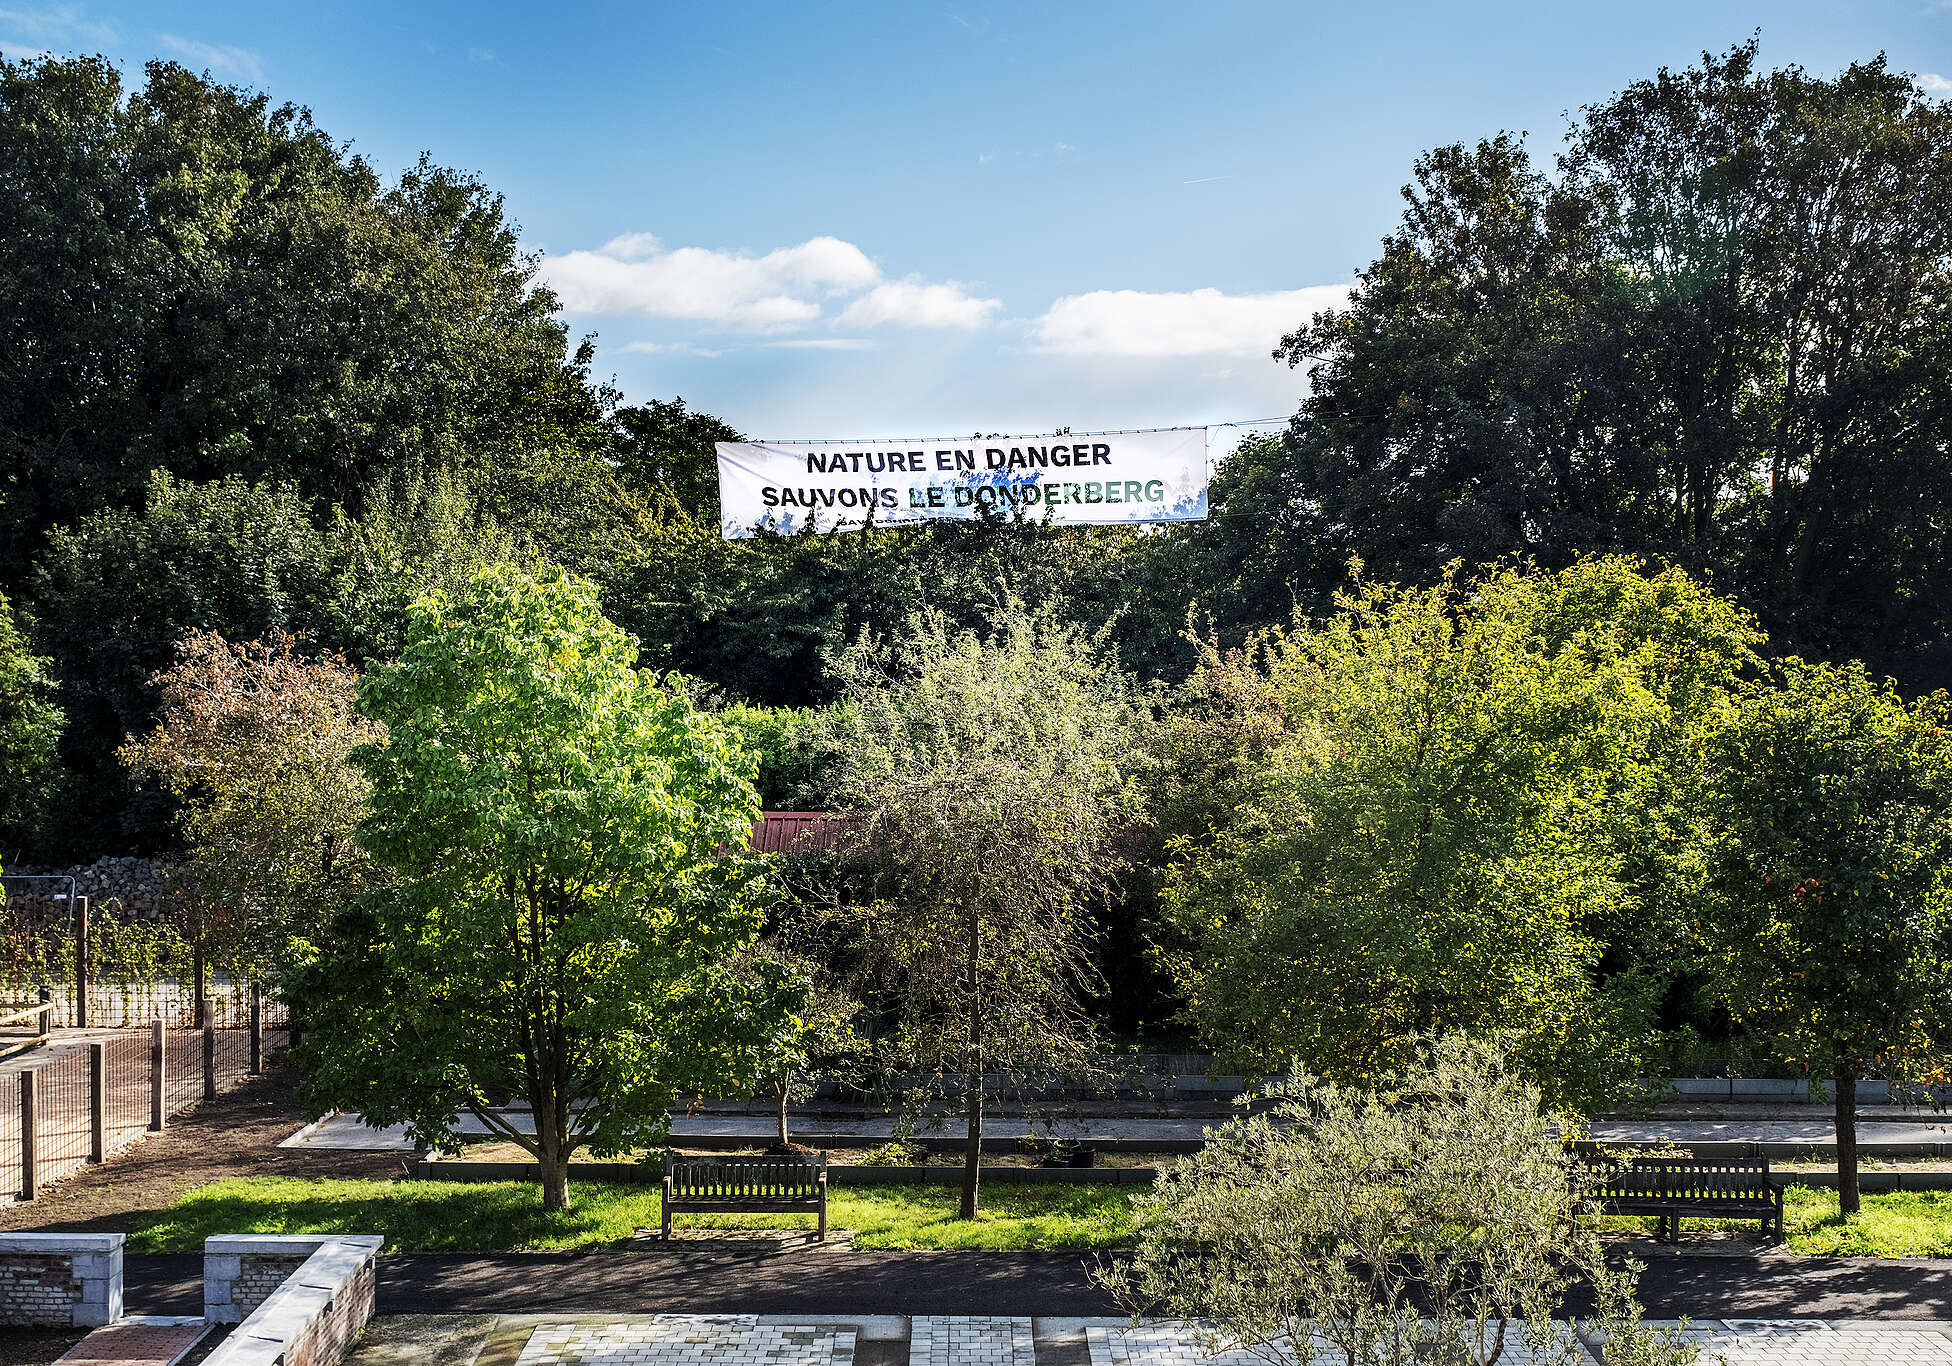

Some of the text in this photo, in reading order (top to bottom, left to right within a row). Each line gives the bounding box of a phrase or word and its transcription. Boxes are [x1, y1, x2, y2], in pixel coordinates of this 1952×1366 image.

[807, 443, 1112, 473] NATURE EN DANGER
[762, 479, 1164, 509] SAUVONS LE DONDERBERG
